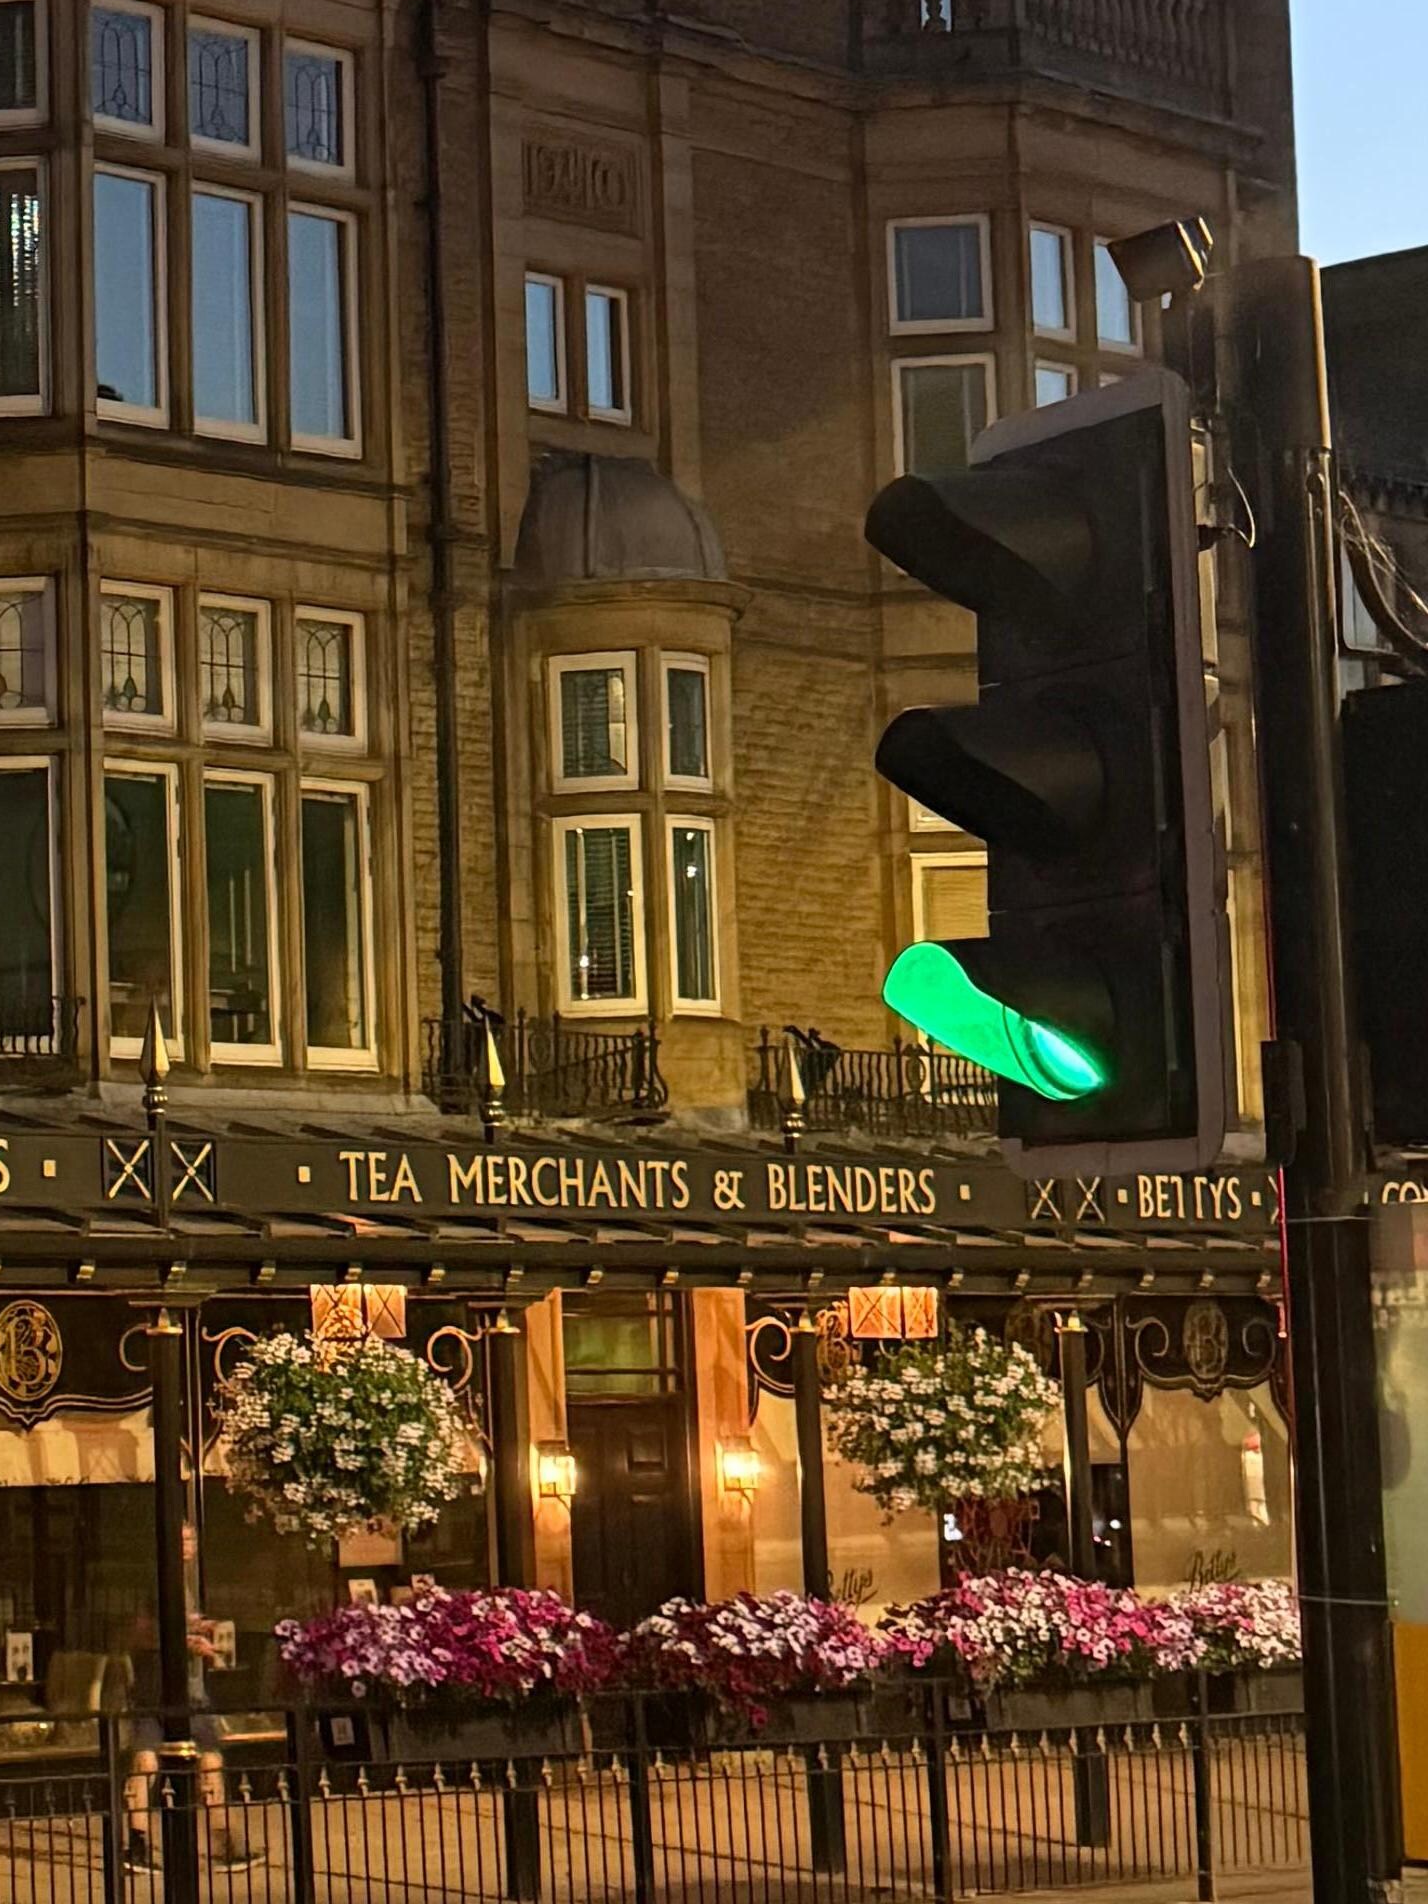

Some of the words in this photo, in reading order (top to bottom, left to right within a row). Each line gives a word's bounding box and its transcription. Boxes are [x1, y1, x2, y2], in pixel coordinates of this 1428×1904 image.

[339, 1151, 423, 1204] TEA
[447, 1154, 691, 1210] MERCHANTS
[712, 1170, 745, 1211] &
[767, 1163, 936, 1215] BLENDERS
[1137, 1174, 1243, 1220] BETTYS
